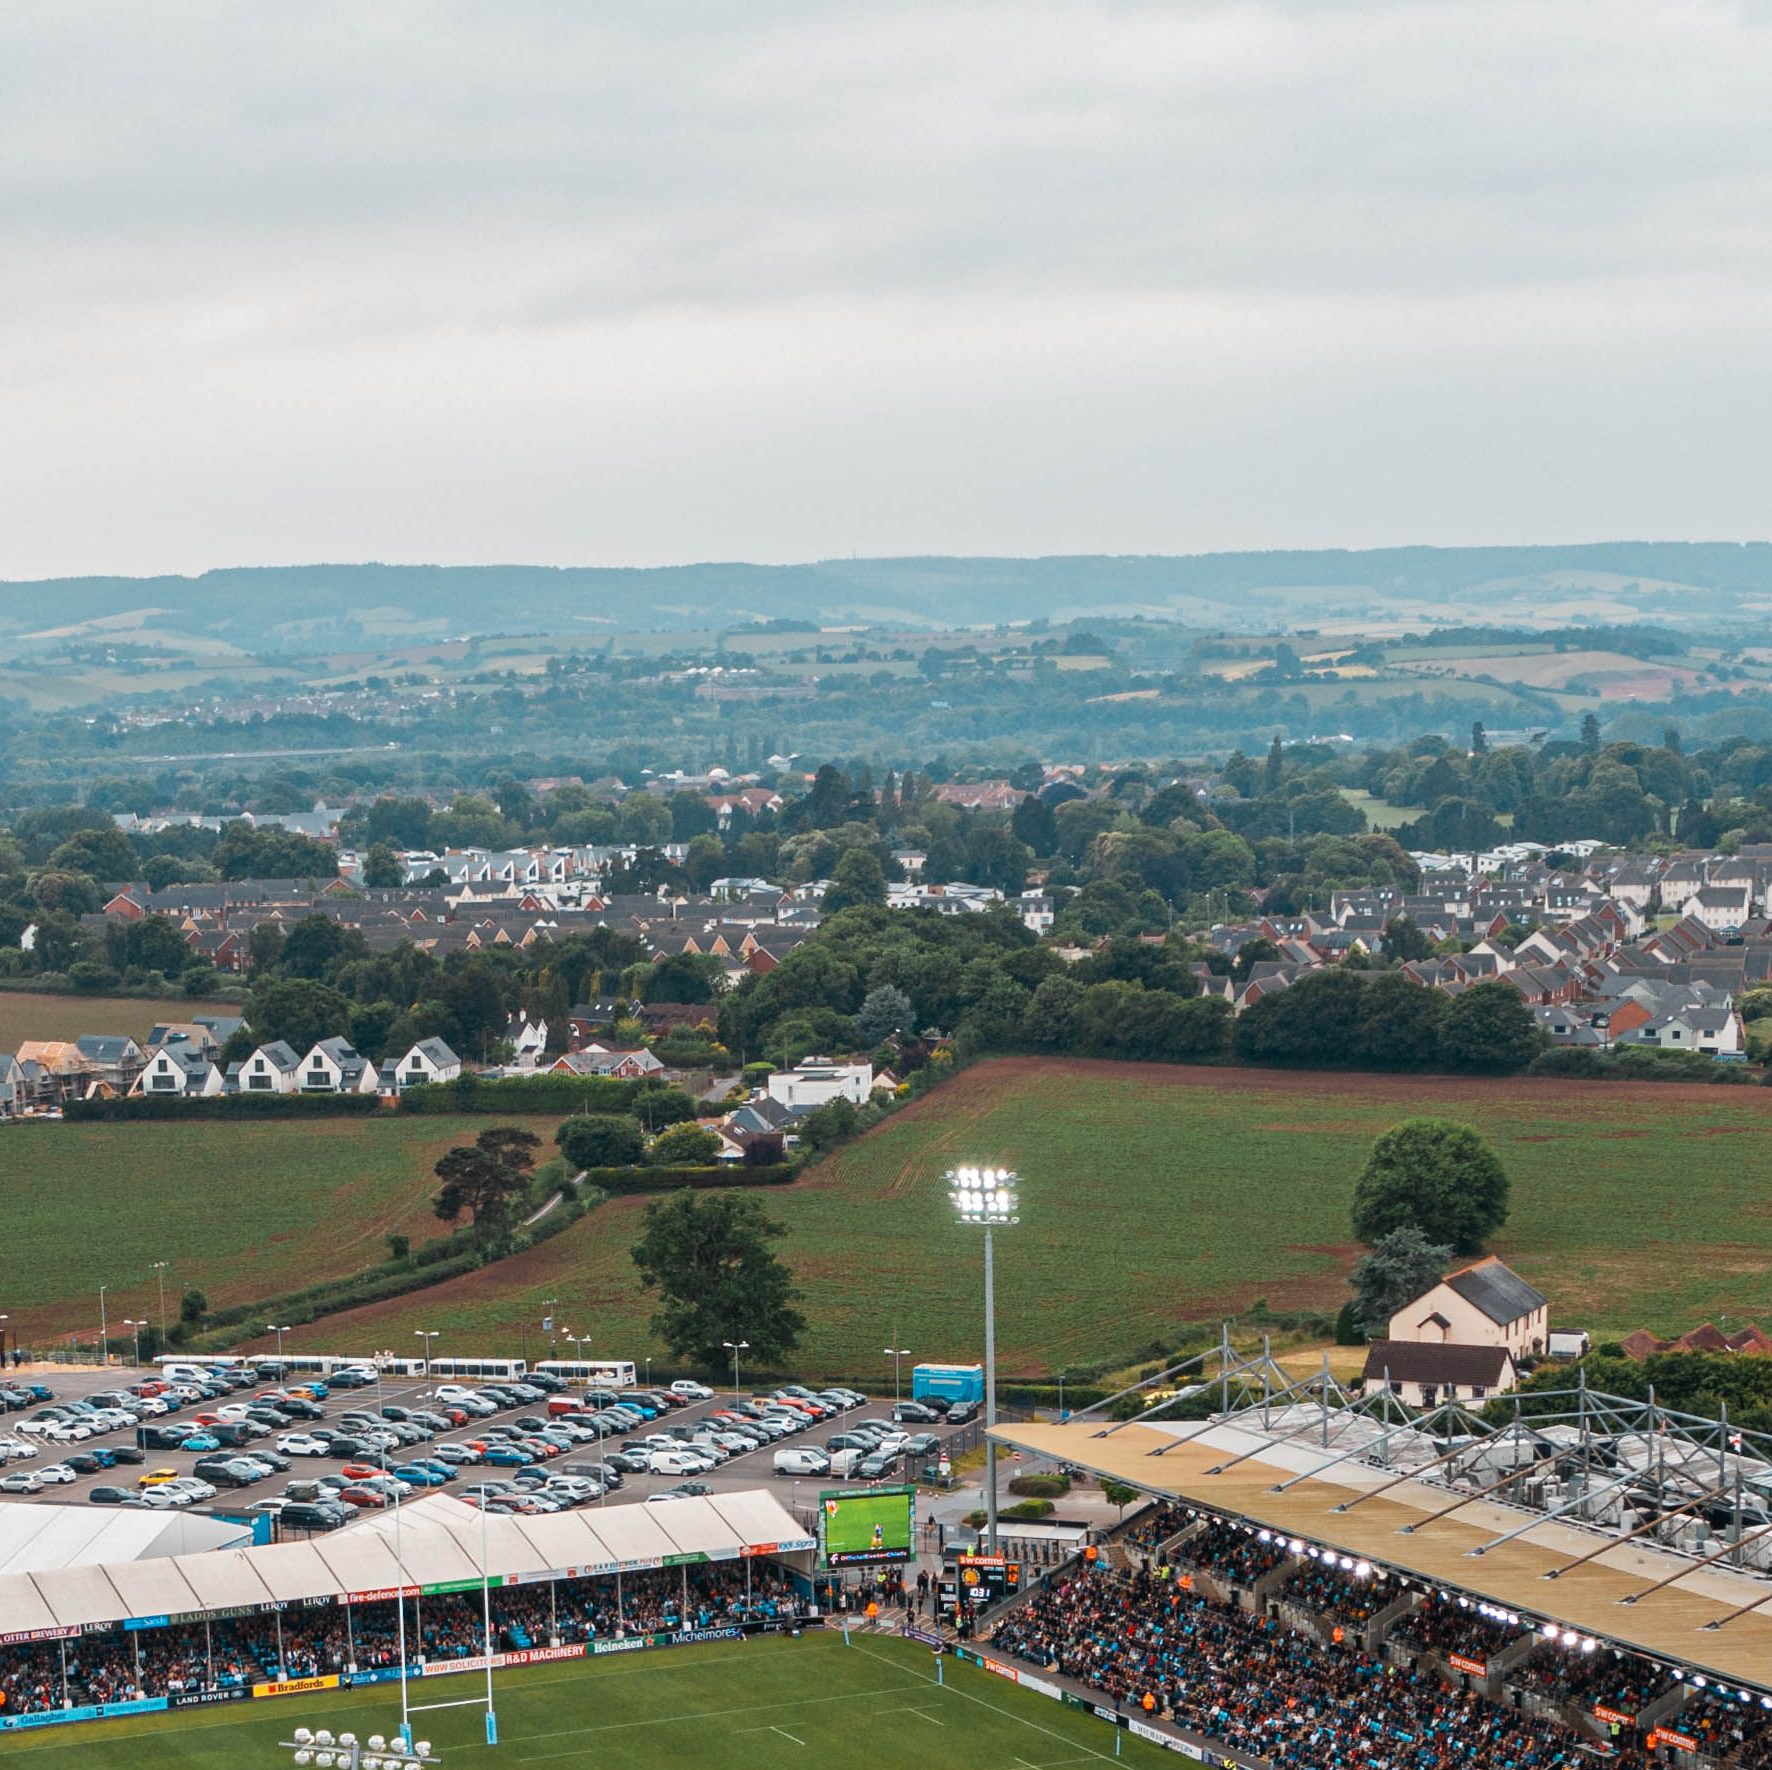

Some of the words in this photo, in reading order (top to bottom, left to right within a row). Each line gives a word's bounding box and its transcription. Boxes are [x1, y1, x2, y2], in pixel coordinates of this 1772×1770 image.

[349, 1588, 420, 1603] fire-defencecom
[221, 1606, 252, 1617] GUNS
[3, 1632, 29, 1643] OTTER
[31, 1627, 68, 1640] BREWERY
[671, 1627, 738, 1644] Michelmores
[594, 1638, 643, 1654] Heineken
[506, 1652, 527, 1665] R&D
[529, 1645, 585, 1662] MACHINERY
[277, 1679, 325, 1693] Bradfords
[176, 1694, 199, 1706] LAND
[201, 1691, 230, 1703] ROVER
[20, 1711, 67, 1726] Gallagher
